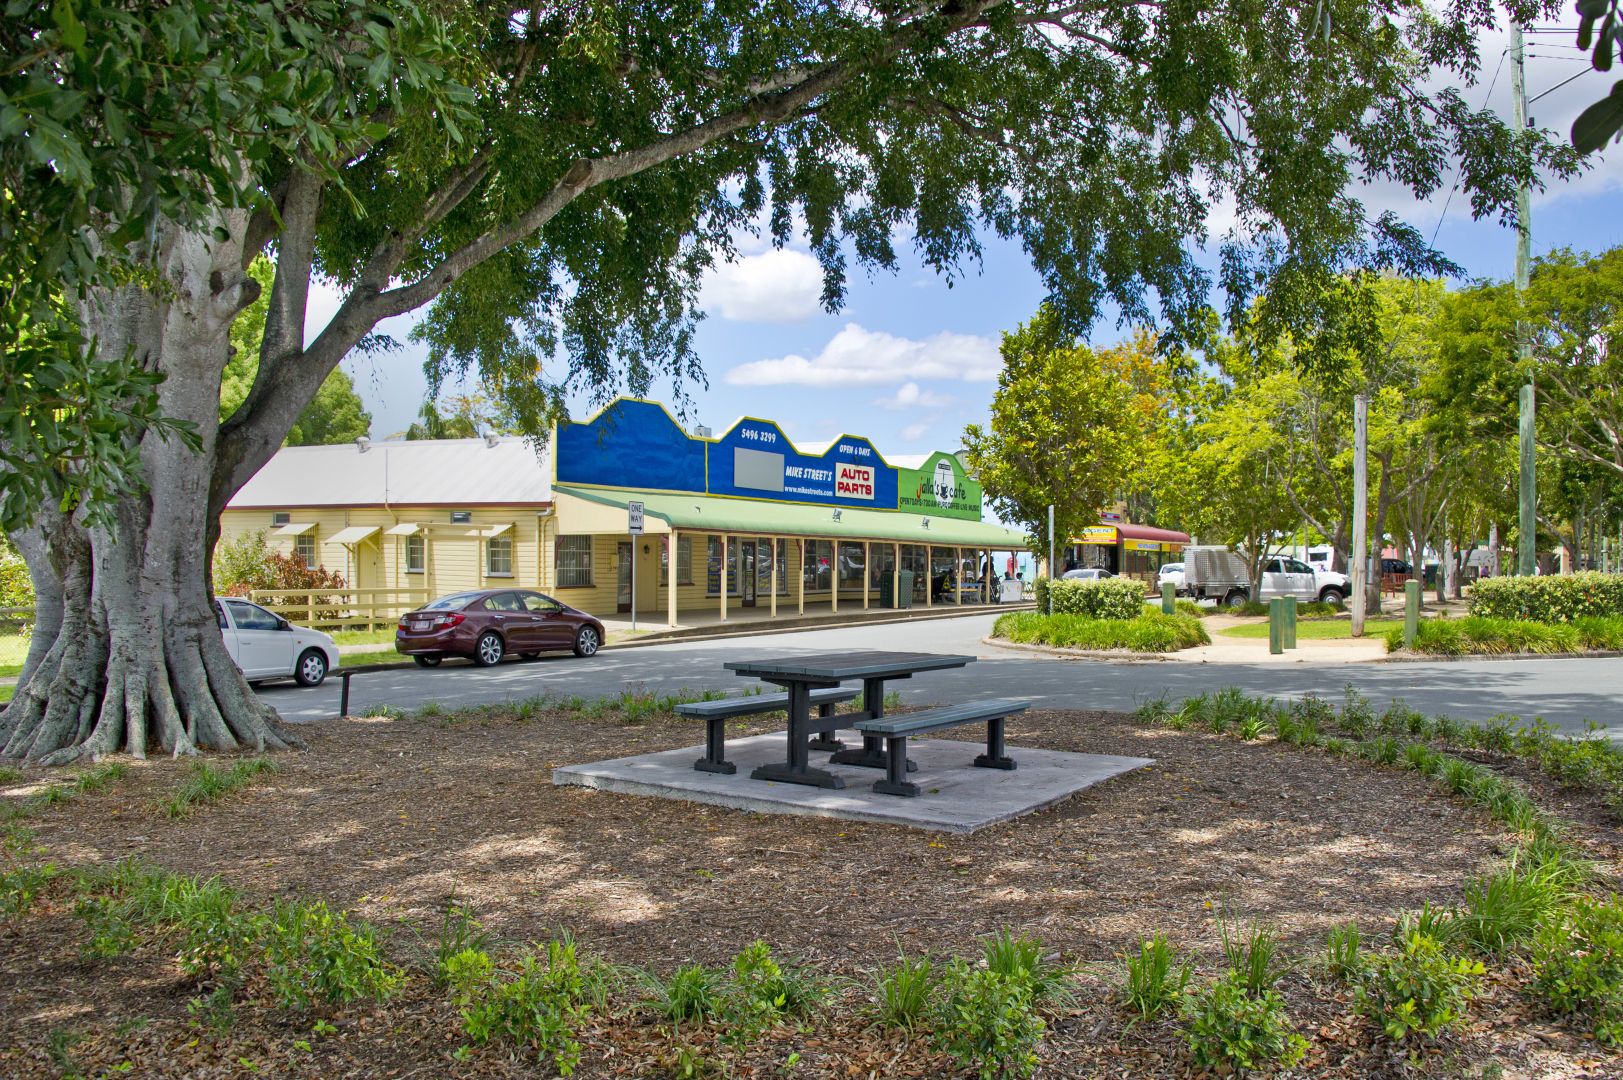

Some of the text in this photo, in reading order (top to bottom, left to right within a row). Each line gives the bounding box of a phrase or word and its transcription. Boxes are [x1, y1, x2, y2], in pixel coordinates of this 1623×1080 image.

[741, 428, 776, 443] 5496 3299
[839, 444, 854, 455] OPEN
[858, 447, 871, 457] DAYS
[785, 465, 833, 482] MIKE STREET'S
[841, 467, 870, 482] AUTO
[784, 486, 833, 497] www.mikestreets.com
[837, 481, 872, 496] PARTS
[949, 482, 966, 499] cafe
[631, 504, 642, 512] ONE
[631, 515, 642, 523] WAY
